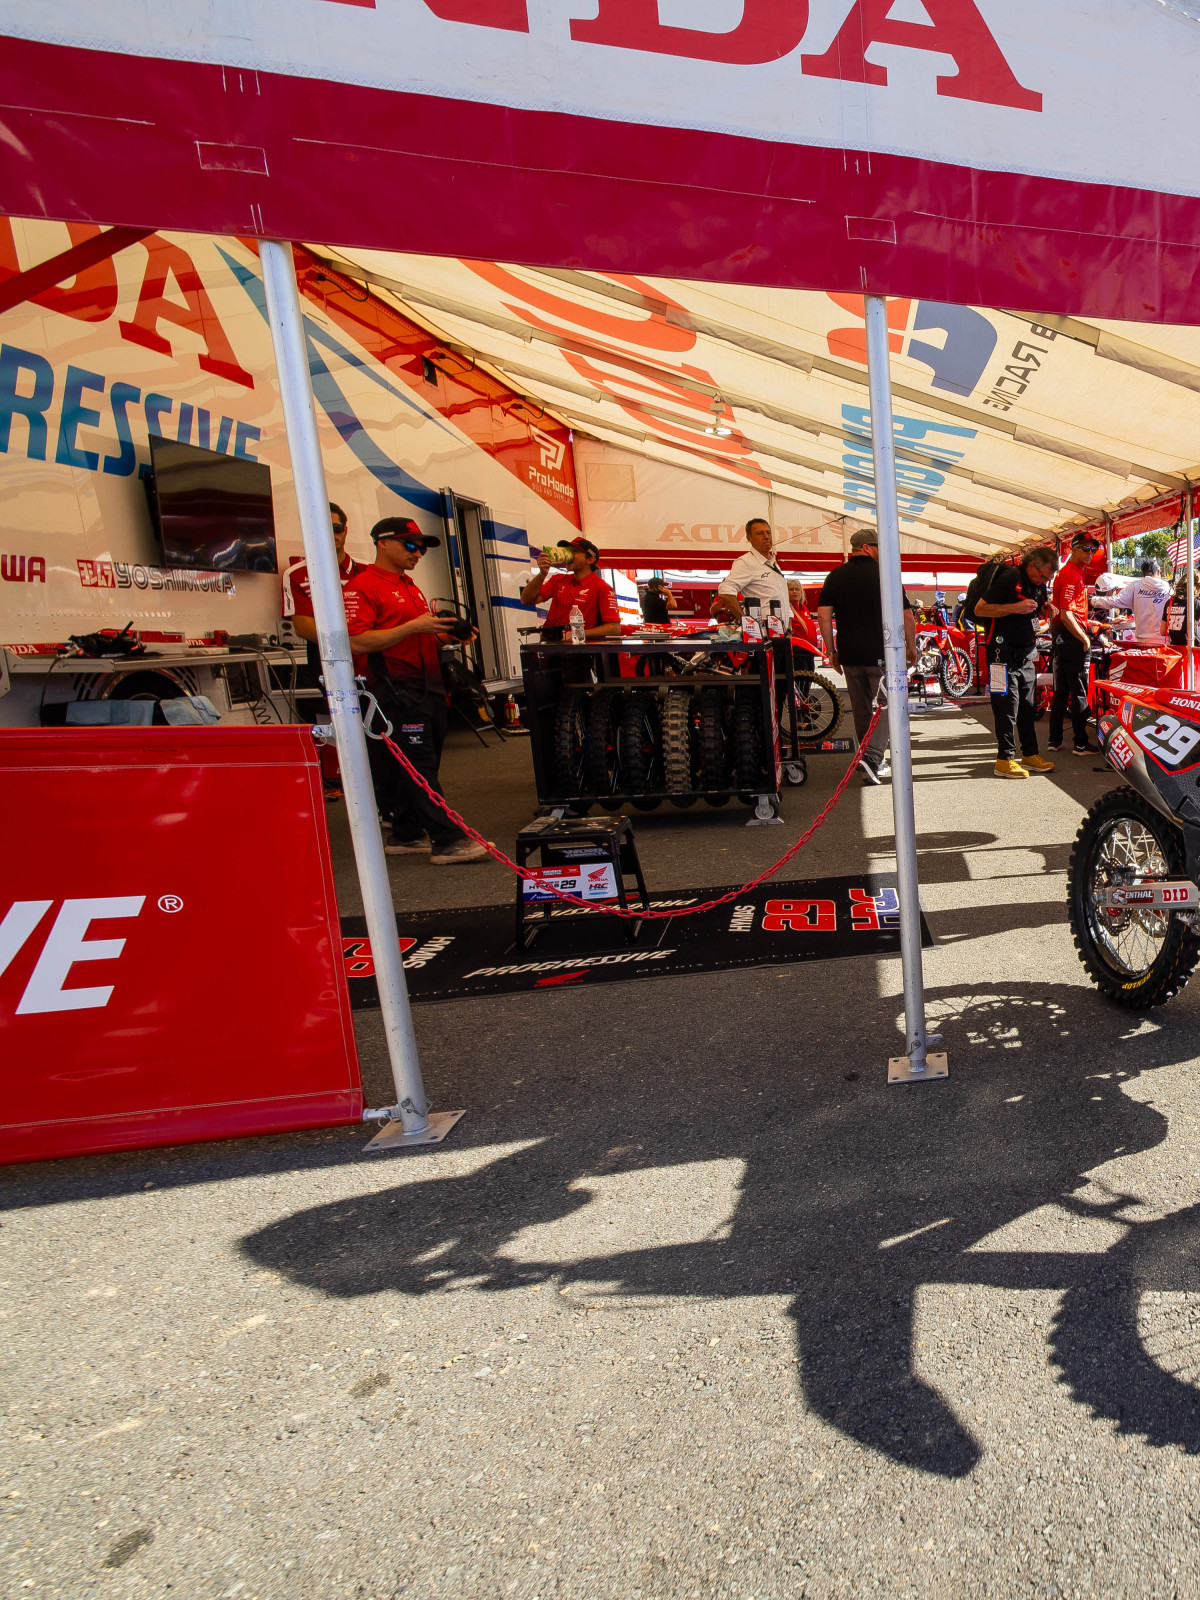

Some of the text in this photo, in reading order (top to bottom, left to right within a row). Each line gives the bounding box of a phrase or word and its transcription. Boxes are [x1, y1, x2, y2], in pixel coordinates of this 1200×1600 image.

[113, 562, 239, 593] YOSHIMURA
[1111, 682, 1145, 694] DUNLOP
[1133, 714, 1200, 765] 29
[560, 880, 576, 889] 29
[728, 905, 756, 932] HYMAS
[761, 899, 837, 931] 29
[403, 936, 455, 970] HYMAS
[462, 949, 677, 979] PROGRESSIVE
